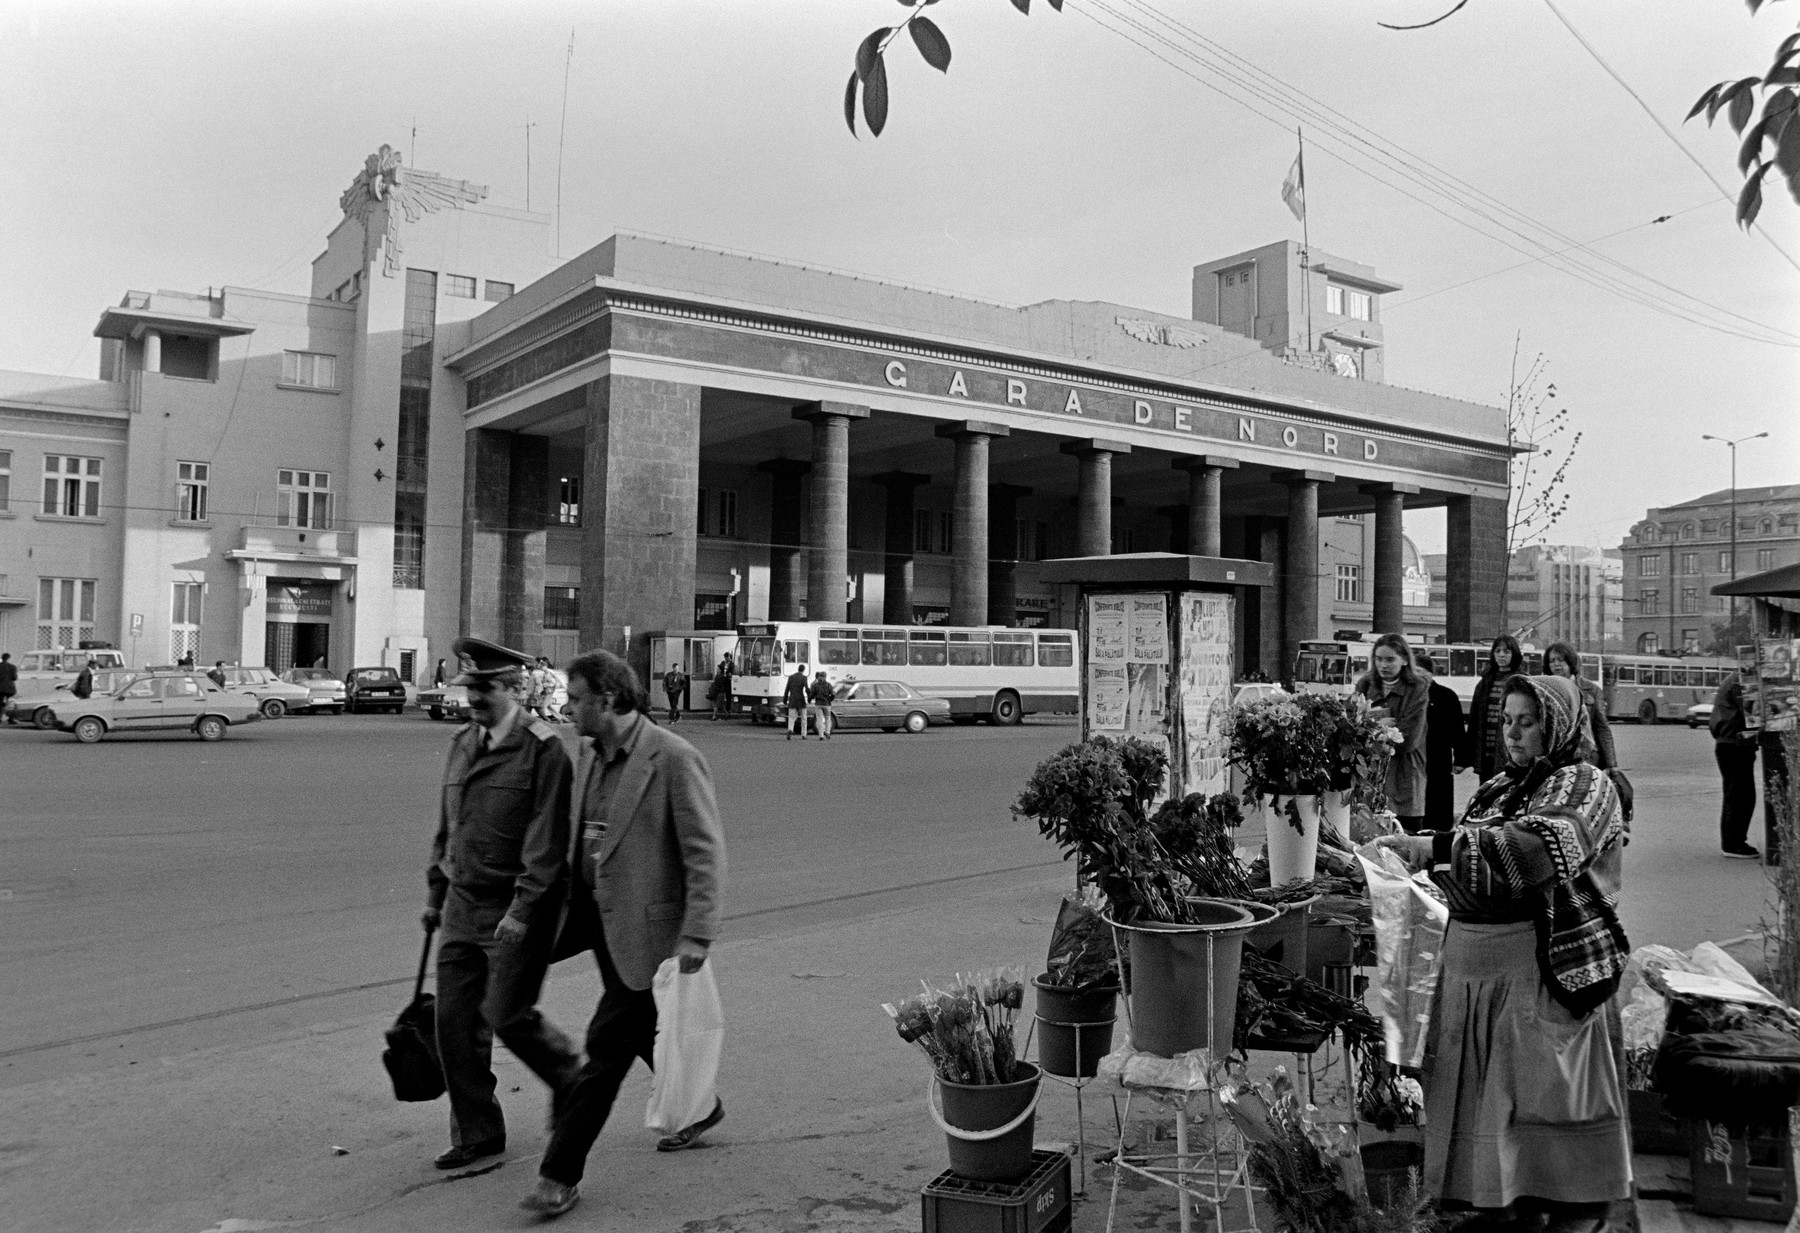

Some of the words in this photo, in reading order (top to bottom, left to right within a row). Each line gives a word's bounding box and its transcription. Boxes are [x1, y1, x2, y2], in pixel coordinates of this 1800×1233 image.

[884, 360, 1084, 414] GARA
[1134, 400, 1192, 432] DE
[1238, 417, 1378, 460] NORD
